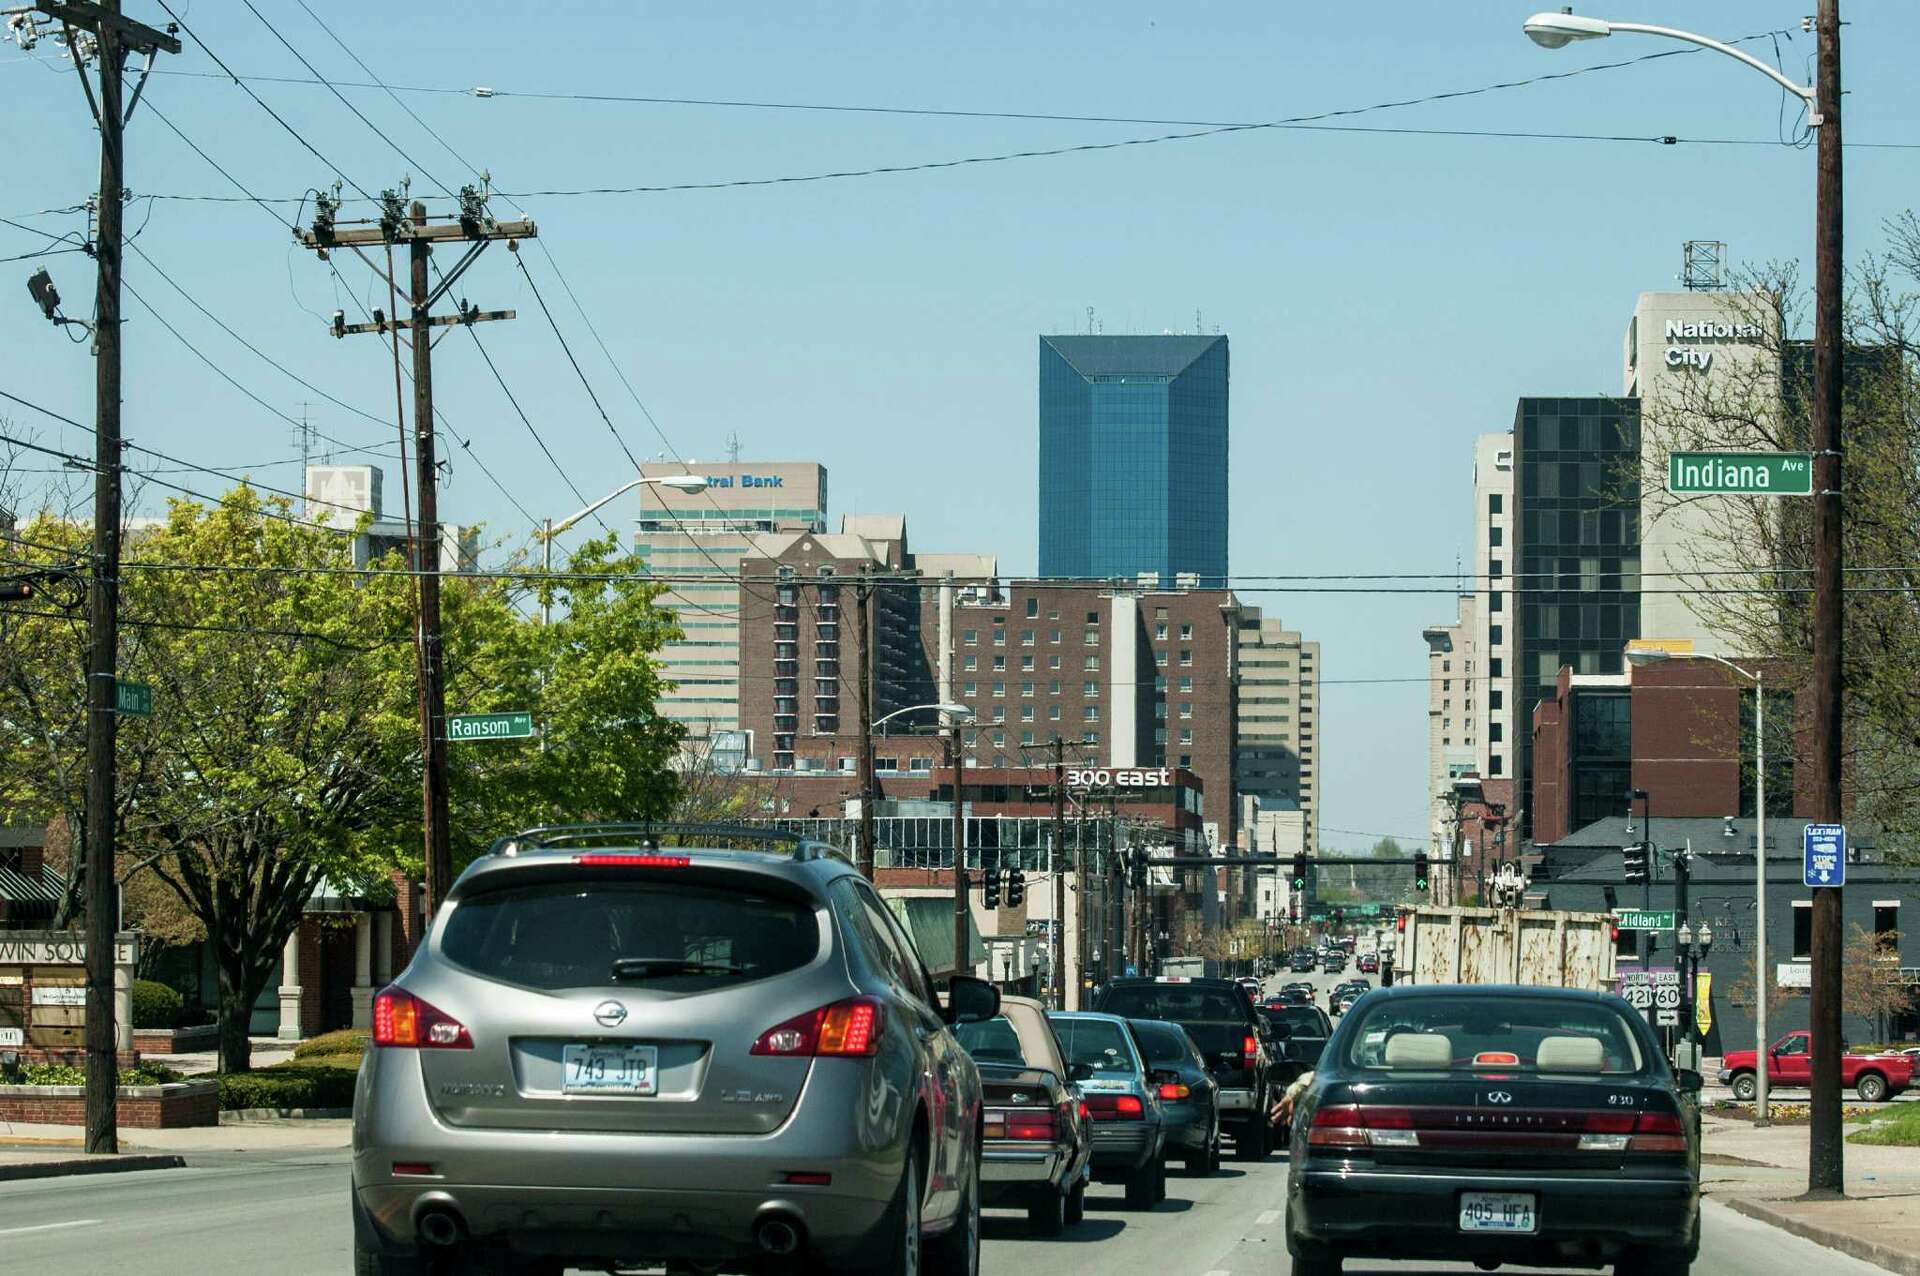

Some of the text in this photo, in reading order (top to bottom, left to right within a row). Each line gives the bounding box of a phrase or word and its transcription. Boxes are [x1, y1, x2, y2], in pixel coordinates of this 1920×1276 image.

[1665, 319, 1763, 338] National
[1664, 346, 1711, 368] City
[741, 474, 783, 488] Bank
[1677, 458, 1804, 488] Indiana Ave
[452, 718, 510, 736] Ransom
[1067, 767, 1170, 786] 300 east
[1618, 911, 1661, 927] Midland
[1659, 974, 1677, 982] EAST
[1625, 989, 1679, 1004] 421 60
[573, 1058, 605, 1080] 743
[1465, 1202, 1531, 1223] 405 HFA
